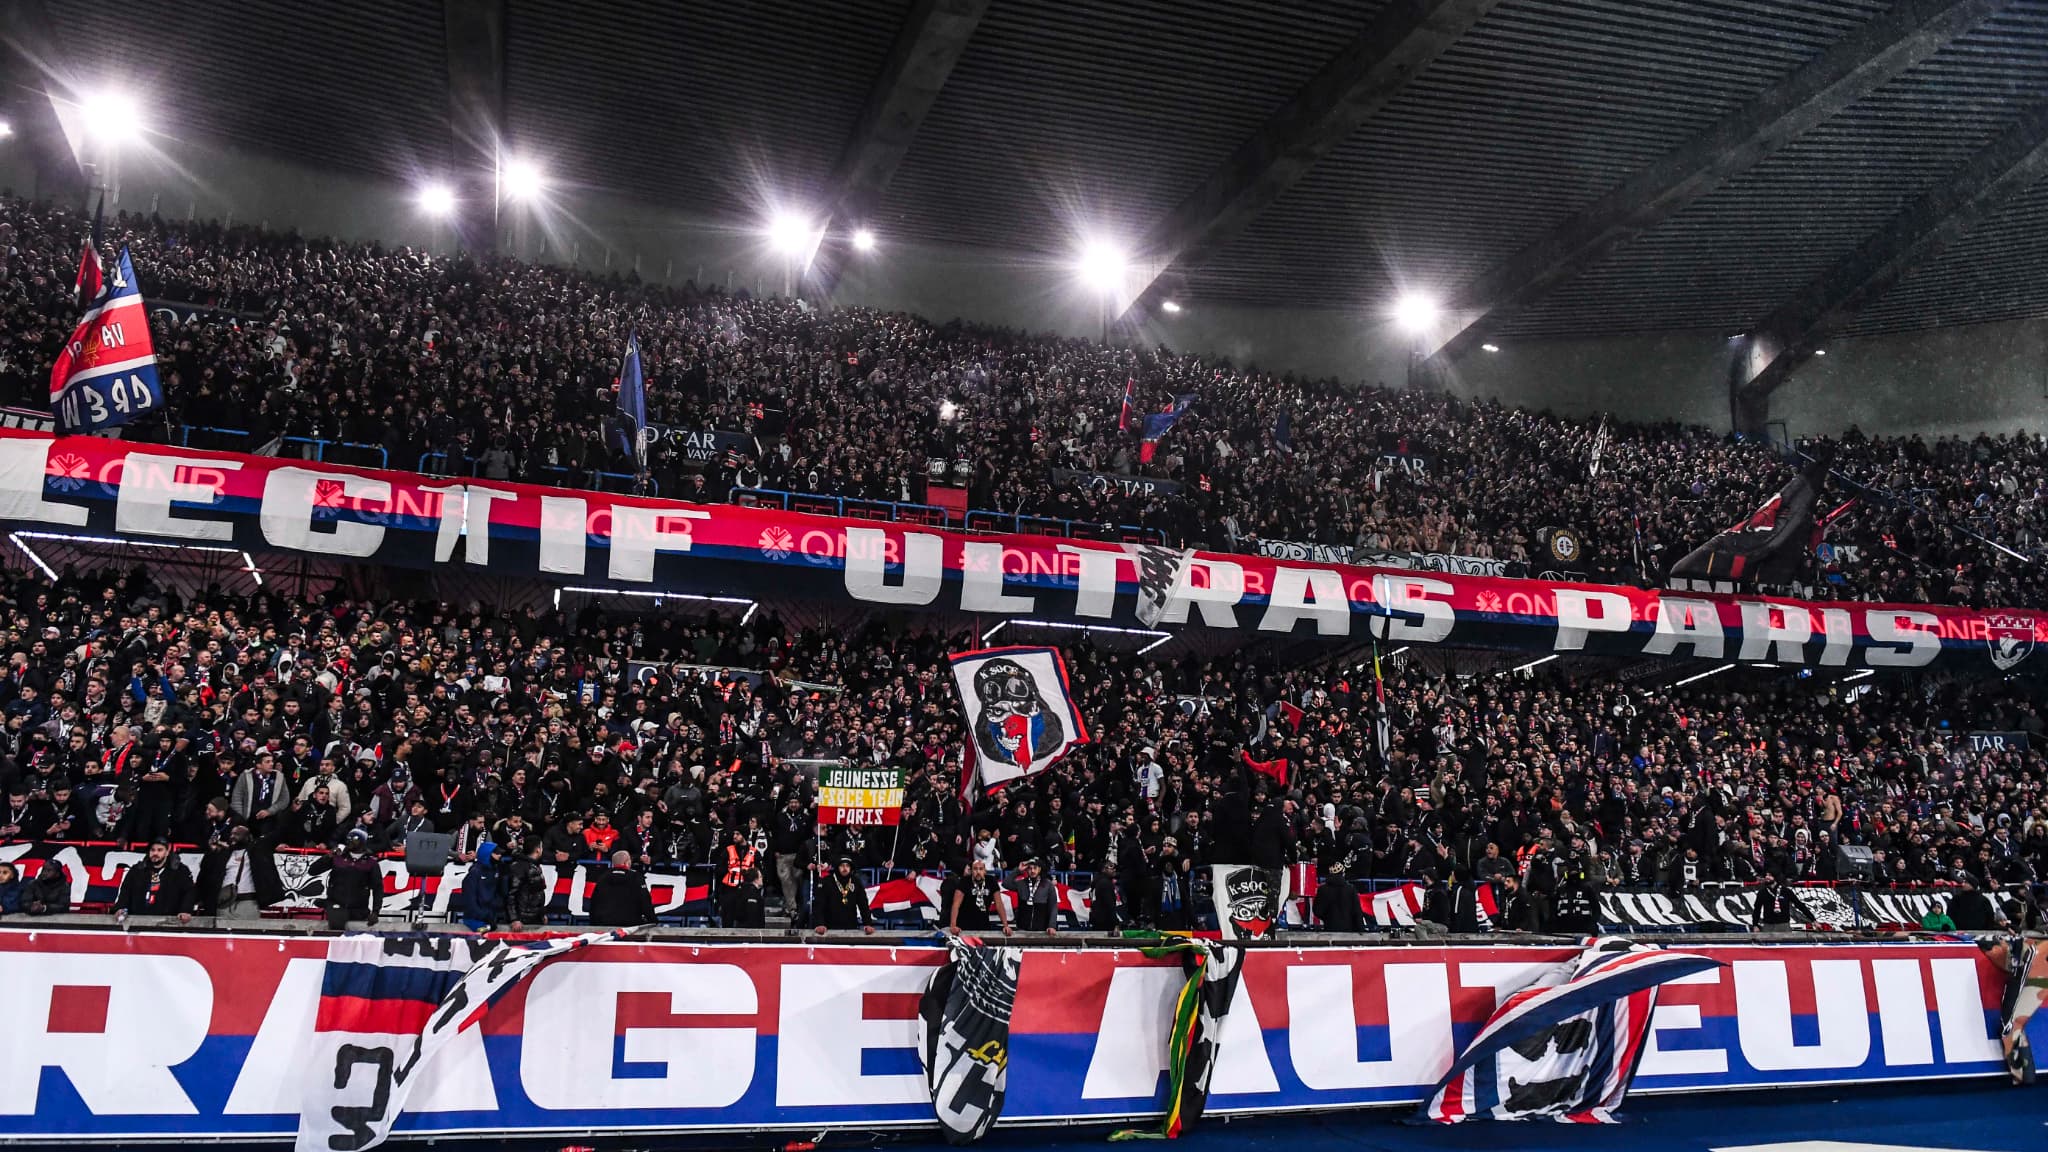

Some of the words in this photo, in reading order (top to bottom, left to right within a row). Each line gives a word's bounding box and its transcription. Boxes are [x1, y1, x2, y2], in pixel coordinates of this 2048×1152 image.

[98, 457, 226, 505] QNB
[1092, 475, 1155, 497] QTAR
[800, 530, 900, 570] QNB
[844, 526, 1455, 642] ULTRAS
[1550, 587, 1942, 667] PARIS
[826, 770, 898, 788] JEUNESSE
[869, 789, 904, 808] TEAM
[836, 808, 884, 825] PARIS
[1229, 880, 1269, 896] K-SOC
[1597, 890, 1766, 926] VIRAG
